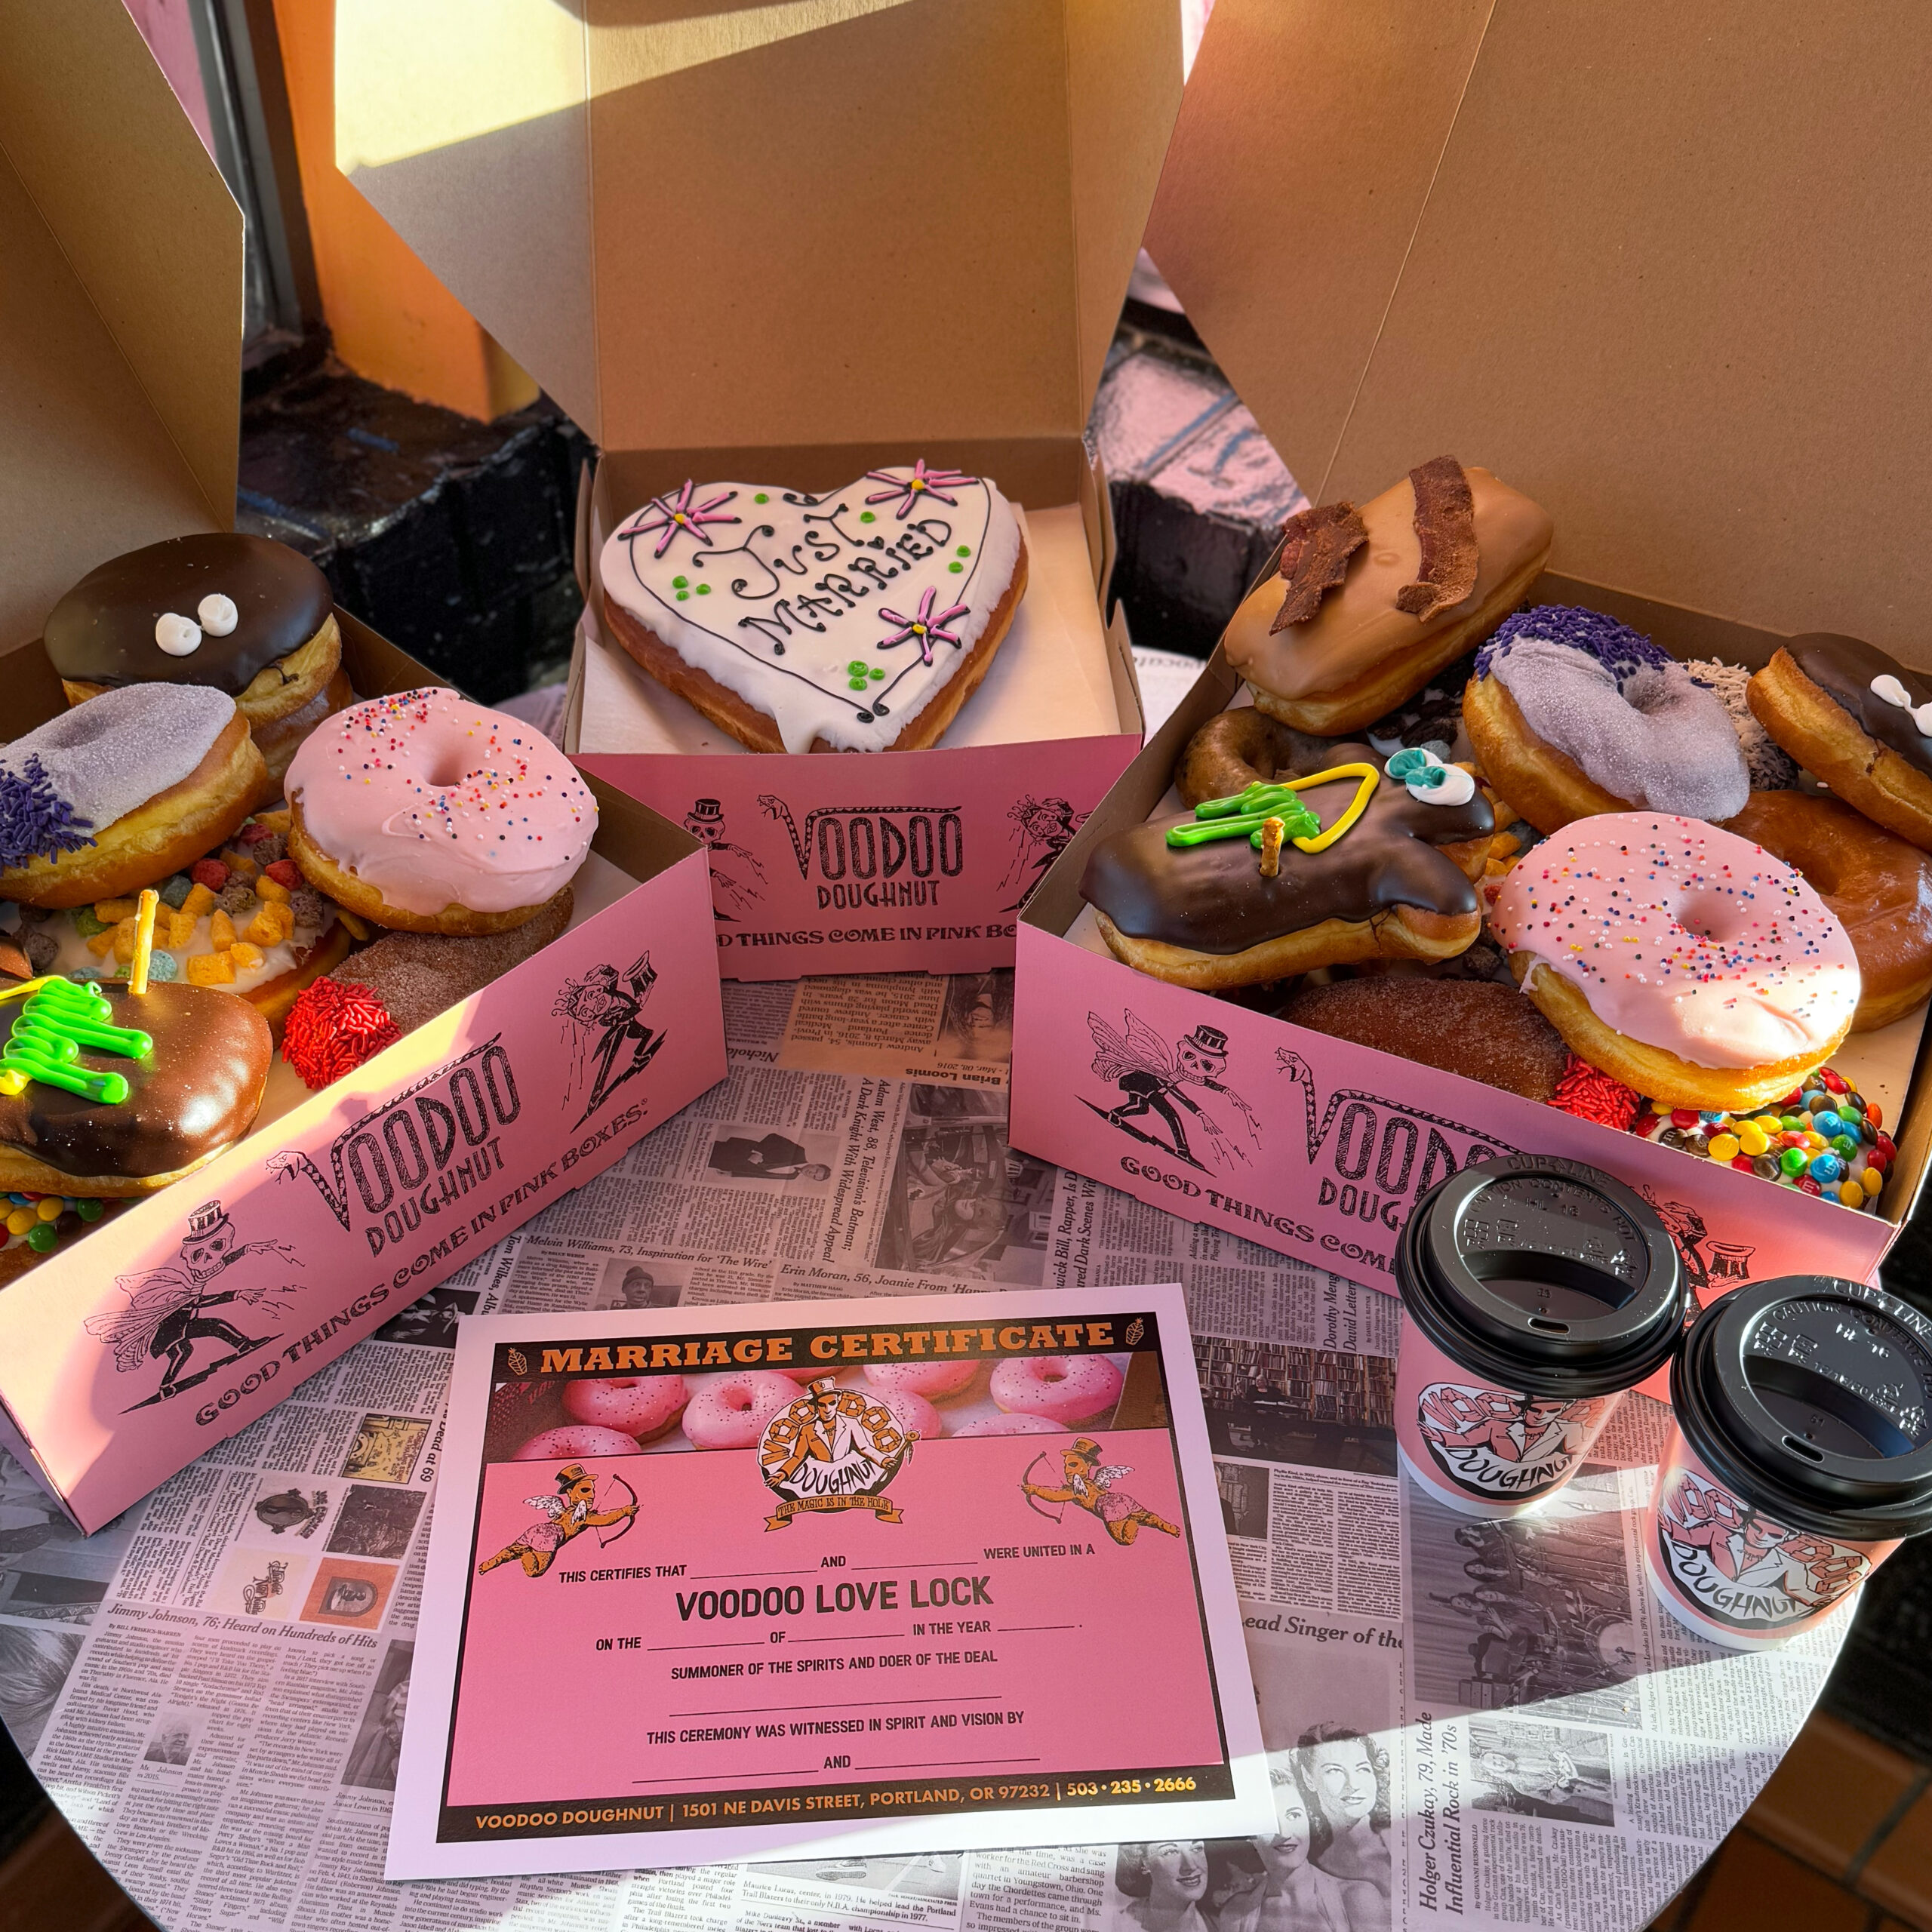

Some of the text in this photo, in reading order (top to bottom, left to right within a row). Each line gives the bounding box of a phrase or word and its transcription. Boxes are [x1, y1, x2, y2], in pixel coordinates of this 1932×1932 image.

[738, 518, 952, 656] MARRIED
[757, 794, 963, 881] VOODOO
[817, 879, 940, 910] DOUGHNUT
[736, 930, 825, 946] THINGS
[828, 927, 896, 943] COME
[900, 926, 922, 940] IN
[925, 924, 982, 940] PINK
[905, 1068, 1001, 1085] Brian Loomis
[266, 1032, 522, 1232] VOODOO
[821, 1077, 875, 1263] A Dark Knight With Widespread Appeal
[841, 1078, 891, 1251] Adam West, 88, Television’s Batman;
[365, 1136, 506, 1259] DOUGHNUT
[1062, 1183, 1077, 1193] Is
[1119, 1155, 1201, 1199] GOOD
[1204, 1189, 1315, 1243] THINGS
[1057, 1195, 1078, 1235] Rapper,
[1076, 1201, 1094, 1237] Scenes
[503, 1234, 522, 1254] Tom
[525, 1234, 564, 1247] Melvin
[567, 1238, 615, 1254] Williams,
[618, 1244, 634, 1256] 73,
[635, 1246, 695, 1261] Inspiration
[696, 1252, 713, 1263] for
[1054, 1238, 1072, 1260] Bill,
[1073, 1237, 1091, 1266] Dark
[488, 1257, 514, 1291] Wilkes,
[780, 1263, 806, 1276] Erin
[807, 1266, 851, 1283] Moran,
[853, 1272, 872, 1285] 56,
[874, 1274, 915, 1288] Joanie
[915, 1278, 948, 1293] From
[195, 1360, 281, 1426] GOOD
[281, 1282, 389, 1364] THINGS
[392, 1225, 469, 1289] COME
[470, 1204, 497, 1235] IN
[498, 1161, 558, 1216] PINK
[1773, 1300, 1841, 1322] CAUTION
[1322, 1305, 1340, 1350] Dorothy
[1342, 1317, 1357, 1352] David
[540, 1321, 1114, 1374] MARRIAGE CERTIFICATE
[761, 1391, 903, 1466] VOODOO
[420, 1466, 435, 1482] 69
[425, 1452, 436, 1466] at
[789, 1459, 877, 1495] DOUGHNUT
[778, 1503, 795, 1516] THE
[797, 1497, 823, 1509] MAGIC
[826, 1497, 834, 1507] IS
[838, 1497, 847, 1506] IN
[850, 1497, 866, 1507] THE
[558, 1543, 1096, 1583] THIS CERTIFIES THAT AND WERE UNITED IN A
[1671, 1540, 1797, 1619] DOUGHNUT
[675, 1575, 994, 1621] VOODOO LOVE LOCK
[106, 1602, 378, 1648] Jimmy Johnson, 76; Heard on Hundreds of Hits
[595, 1620, 992, 1651] ON THE OF IN THE YEAR
[1241, 1614, 1282, 1633] ead
[1284, 1617, 1349, 1642] Singer
[1352, 1627, 1377, 1644] of
[670, 1649, 998, 1680] SUMMONER OF THE SPIRITS AND DOER OF THE DEAL
[646, 1710, 1024, 1745] THIS CEREMONY WAS WITNESSED IN SPIRIT AND VISION BY
[823, 1755, 851, 1769] AND
[1442, 1761, 1459, 1777] in
[475, 1811, 558, 1829] VOODOO
[561, 1805, 664, 1824] DOUGHNUT
[682, 1802, 717, 1817] 1501
[723, 1801, 746, 1815] NE
[750, 1797, 801, 1814] DAVIS
[805, 1793, 865, 1810] STREET,
[869, 1788, 964, 1806] PORTLAND,
[969, 1786, 995, 1801] OR
[998, 1783, 1051, 1799] 97232
[1414, 1711, 1441, 1912] Holger Czukay, 79, Made
[1441, 1780, 1460, 1819] Rock
[1442, 1817, 1463, 1915] Influential
[969, 1900, 994, 1911] Evans
[995, 1903, 1011, 1913] had
[1019, 1907, 1048, 1918] chance
[1048, 1912, 1058, 1920] to
[1058, 1913, 1069, 1922] sit
[1070, 1914, 1081, 1924] in.
